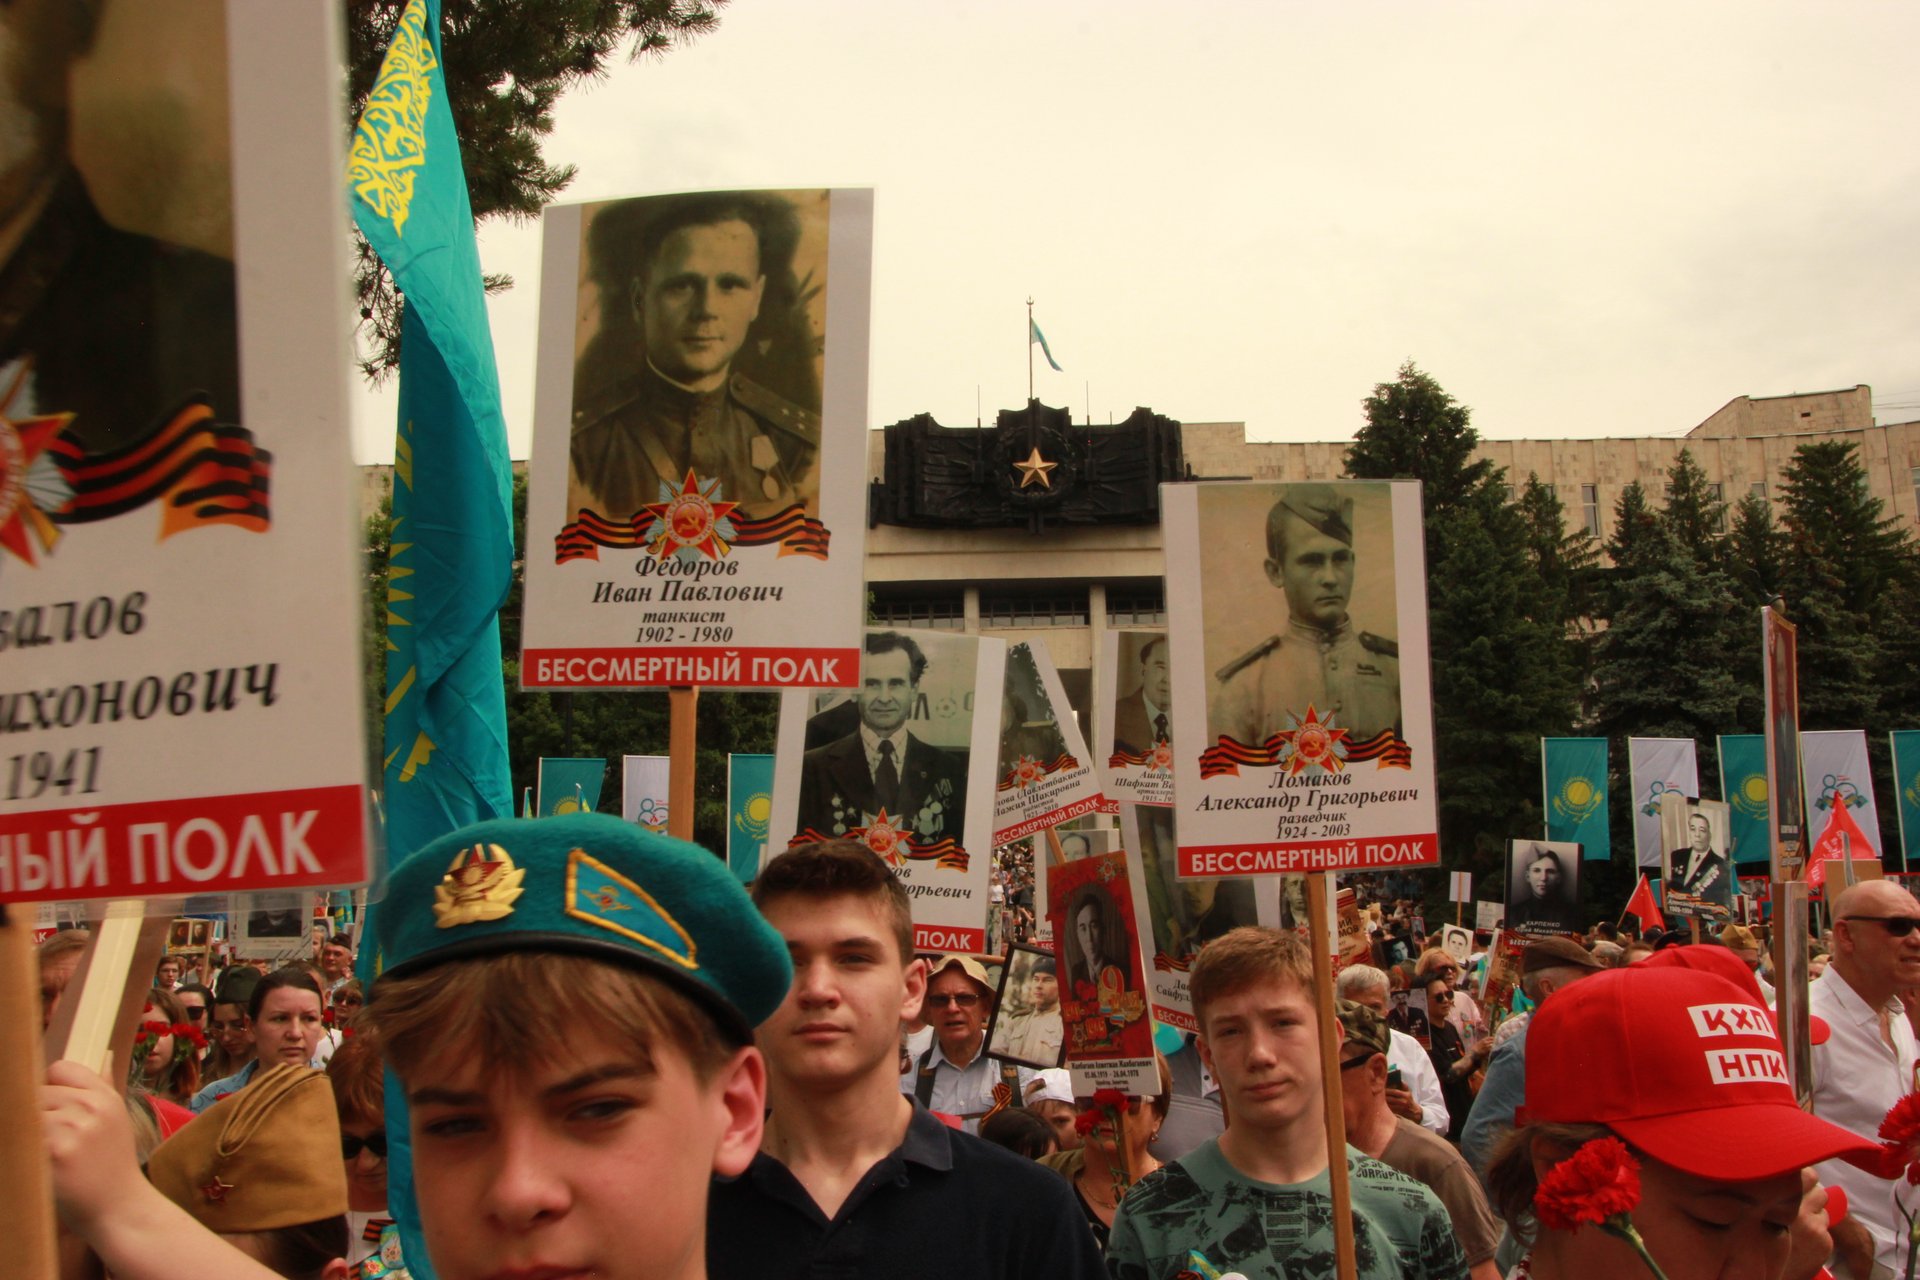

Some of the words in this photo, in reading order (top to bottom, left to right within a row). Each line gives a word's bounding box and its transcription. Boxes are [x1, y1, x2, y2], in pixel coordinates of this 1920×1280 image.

[635, 554, 739, 582] Фёдоров
[592, 581, 652, 604] Иван
[657, 579, 784, 603] Павлович
[641, 609, 726, 624] танкист
[635, 626, 674, 643] 1902
[690, 626, 734, 643] 1980
[537, 651, 742, 683] БЕССМЕРТНЫЙ
[752, 657, 840, 683] ПОЛК
[1269, 771, 1352, 789] Ломаков
[1068, 798, 1100, 815] ПОЛК
[1195, 792, 1301, 813] Александр
[1306, 788, 1419, 811] Григорьевич
[1278, 811, 1348, 825] разведчик
[1277, 825, 1308, 840] 1924
[1322, 823, 1351, 838] 2003
[128, 809, 326, 886] ПОЛК
[1191, 842, 1359, 873] БЕССМЕРТНЫЙ
[1365, 841, 1425, 863] ПОЛК
[1525, 920, 1561, 928] КАРПЕНКО
[915, 930, 972, 950] ПОЛК
[1718, 1054, 1785, 1079] НПК
